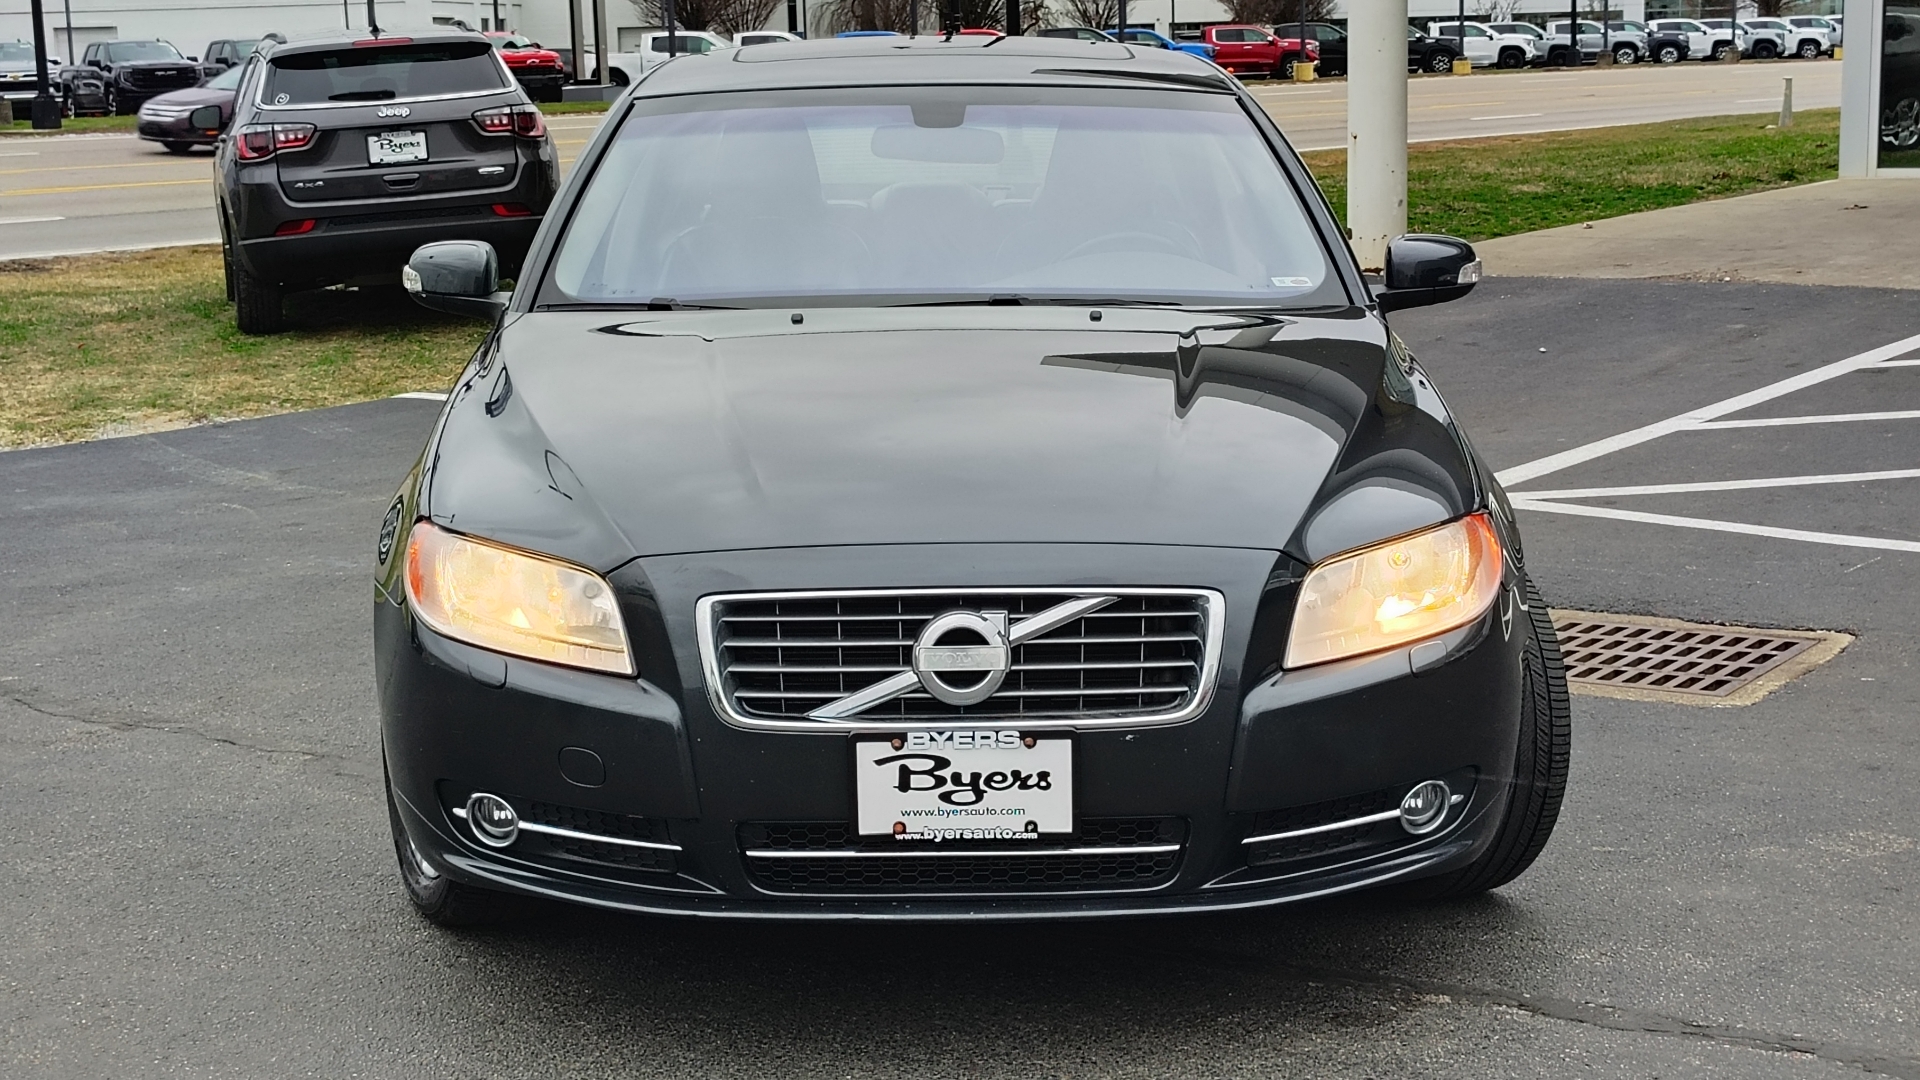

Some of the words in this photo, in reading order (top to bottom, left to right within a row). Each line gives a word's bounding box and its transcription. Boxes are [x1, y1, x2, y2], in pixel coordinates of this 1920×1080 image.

[377, 105, 411, 118] Jeep
[907, 730, 1021, 750] BYERS
[872, 753, 1052, 806] Byers
[900, 806, 1026, 818] www.byersauto.com
[895, 826, 1038, 842] www.byersauto.com
